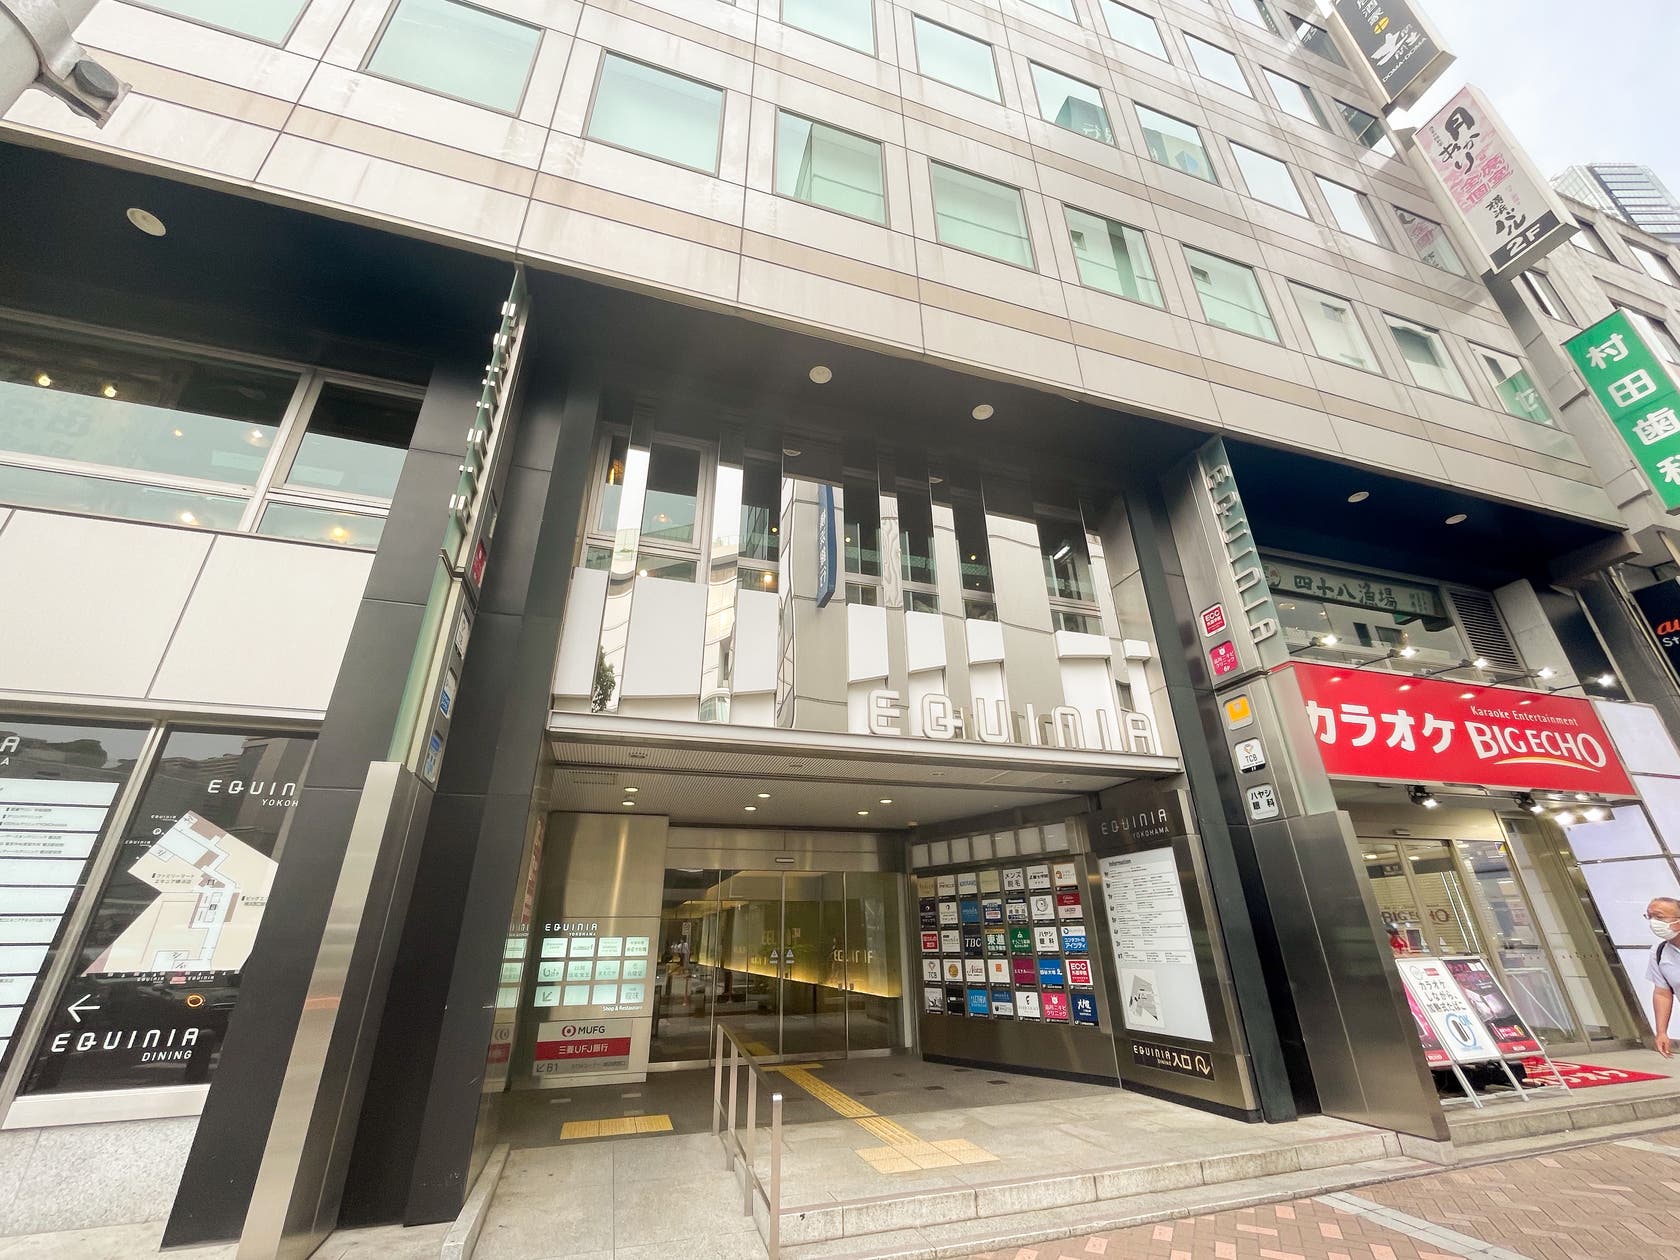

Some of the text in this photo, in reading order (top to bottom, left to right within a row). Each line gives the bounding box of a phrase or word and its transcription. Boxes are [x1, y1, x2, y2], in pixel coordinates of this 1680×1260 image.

[1506, 223, 1541, 257] 2F
[1207, 464, 1278, 645] EQUINIA
[1204, 609, 1221, 622] ECC
[1470, 705, 1579, 728] Karaoke Entertainment
[868, 690, 1158, 757] EQUINIA
[1306, 700, 1455, 753] カラオケ
[1245, 754, 1258, 763] TCB
[1250, 789, 1271, 800] ハヤシ
[1101, 808, 1168, 835] EQUINIA
[1132, 826, 1170, 839] YOKOHAMA
[544, 923, 598, 932] EQUINIA
[964, 938, 982, 948] TBC
[1419, 980, 1446, 990] カラオケ
[577, 1025, 606, 1035] MUFG
[51, 1027, 200, 1053] EQUINIA
[141, 1050, 193, 1062] DINING
[1133, 1045, 1193, 1070] EQUINIA 入口
[546, 1062, 559, 1072] B1
